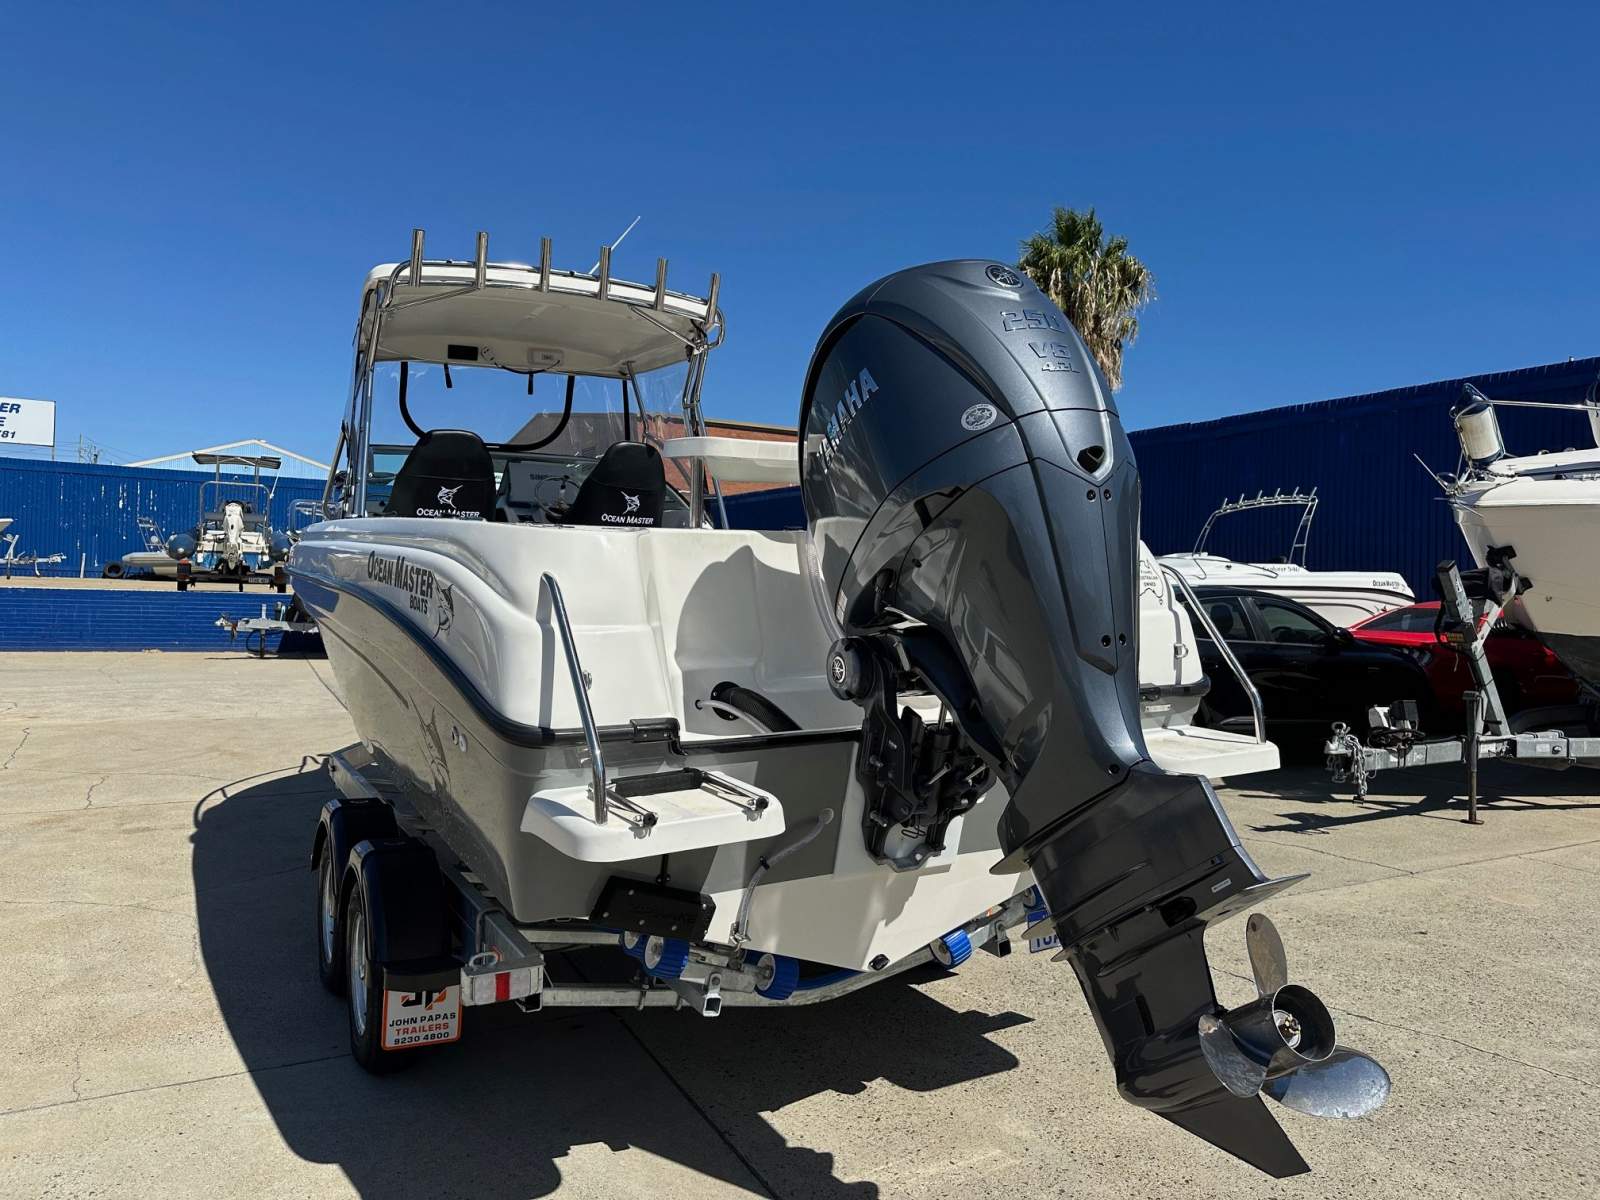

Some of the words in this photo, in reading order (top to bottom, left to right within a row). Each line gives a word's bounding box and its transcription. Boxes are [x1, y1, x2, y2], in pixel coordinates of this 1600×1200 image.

[0, 430, 16, 439] 81
[601, 513, 626, 524] OCEAN
[626, 515, 654, 525] MASTER
[367, 550, 394, 586] OCEAN
[394, 555, 434, 599] MASTER
[409, 594, 428, 615] BOATS
[389, 1016, 418, 1028] JOHN
[420, 1012, 456, 1024] PAPAS
[395, 1022, 449, 1036] TRAILERS
[394, 1035, 420, 1046] 9230
[423, 1031, 450, 1041] 4800
